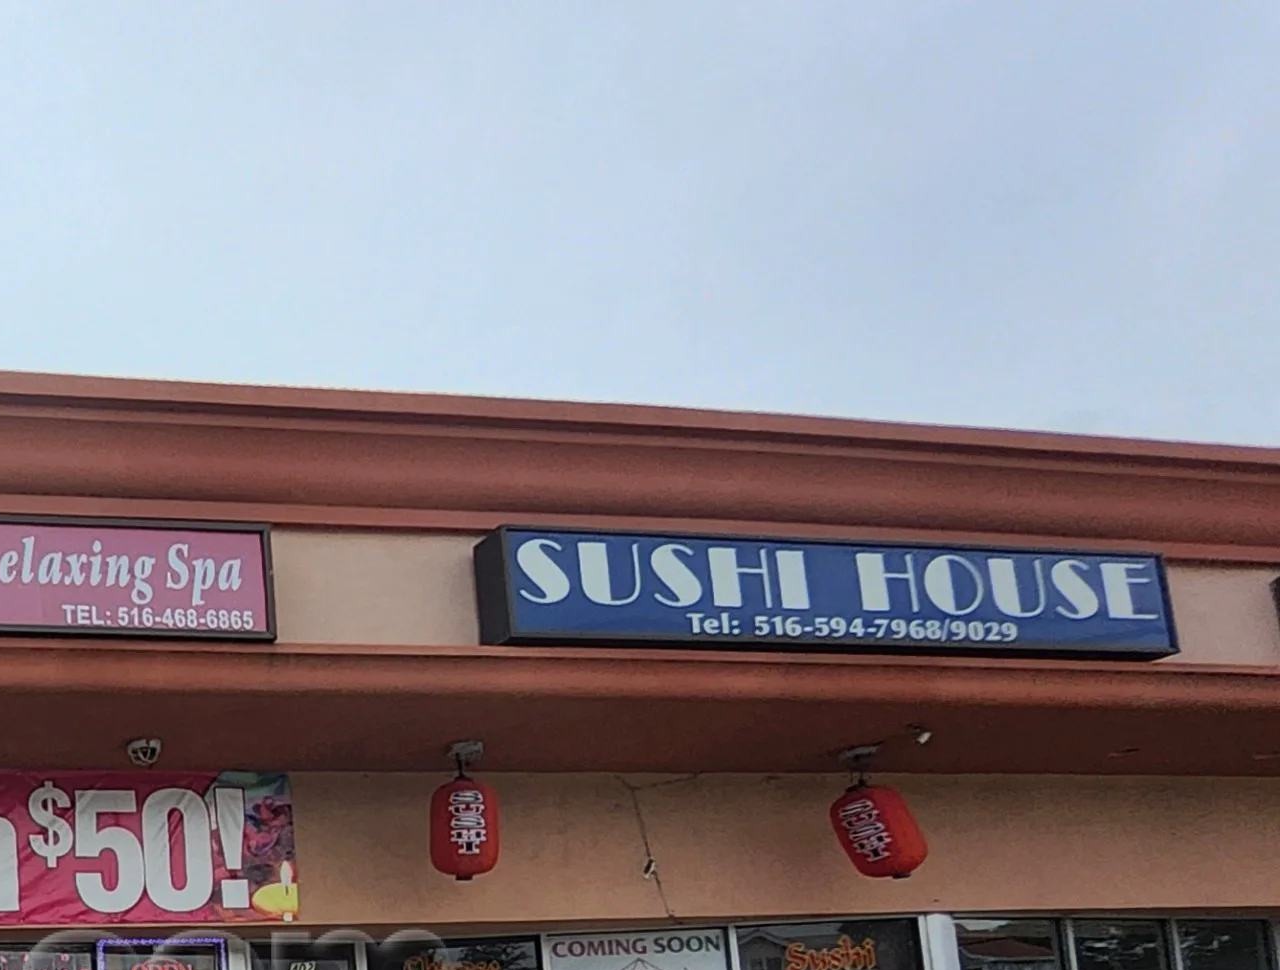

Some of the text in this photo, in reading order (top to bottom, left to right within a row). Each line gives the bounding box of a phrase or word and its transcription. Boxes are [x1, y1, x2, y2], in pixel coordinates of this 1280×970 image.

[166, 543, 242, 606] Spa
[516, 538, 1160, 621] SUSHI HOUSE
[61, 604, 254, 631] TEL: 516-468-6865
[685, 611, 1018, 643] Tel: 516-594-7968/9029
[28, 780, 251, 913] $50!
[552, 935, 721, 957] COMING SOON
